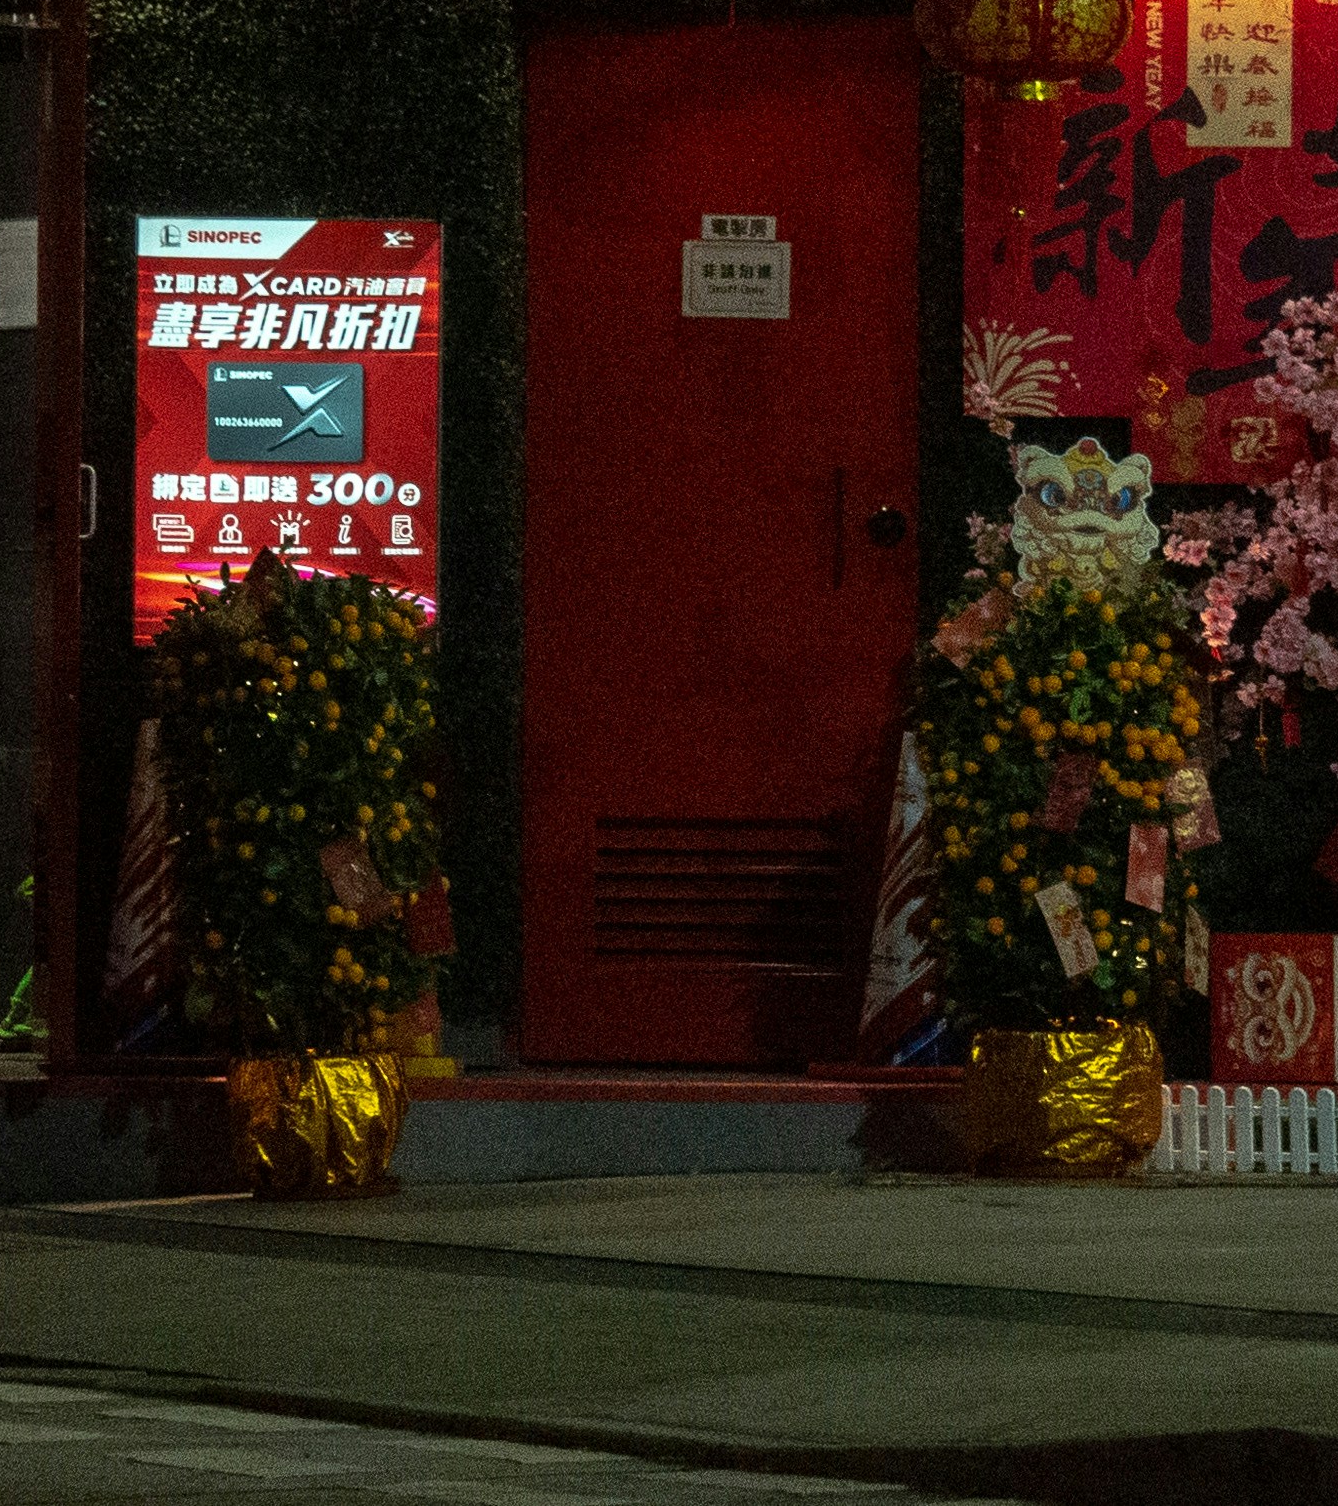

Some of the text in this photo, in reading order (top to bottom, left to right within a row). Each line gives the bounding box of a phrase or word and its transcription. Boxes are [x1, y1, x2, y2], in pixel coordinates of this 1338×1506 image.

[1145, 0, 1163, 50] NEW
[187, 230, 262, 244] SINOPEC
[148, 301, 422, 351] 盡享非凡折扣
[229, 370, 274, 381] SINOPEC
[151, 473, 207, 502] 綁定
[243, 475, 298, 504] 即送
[306, 472, 395, 506] 300
